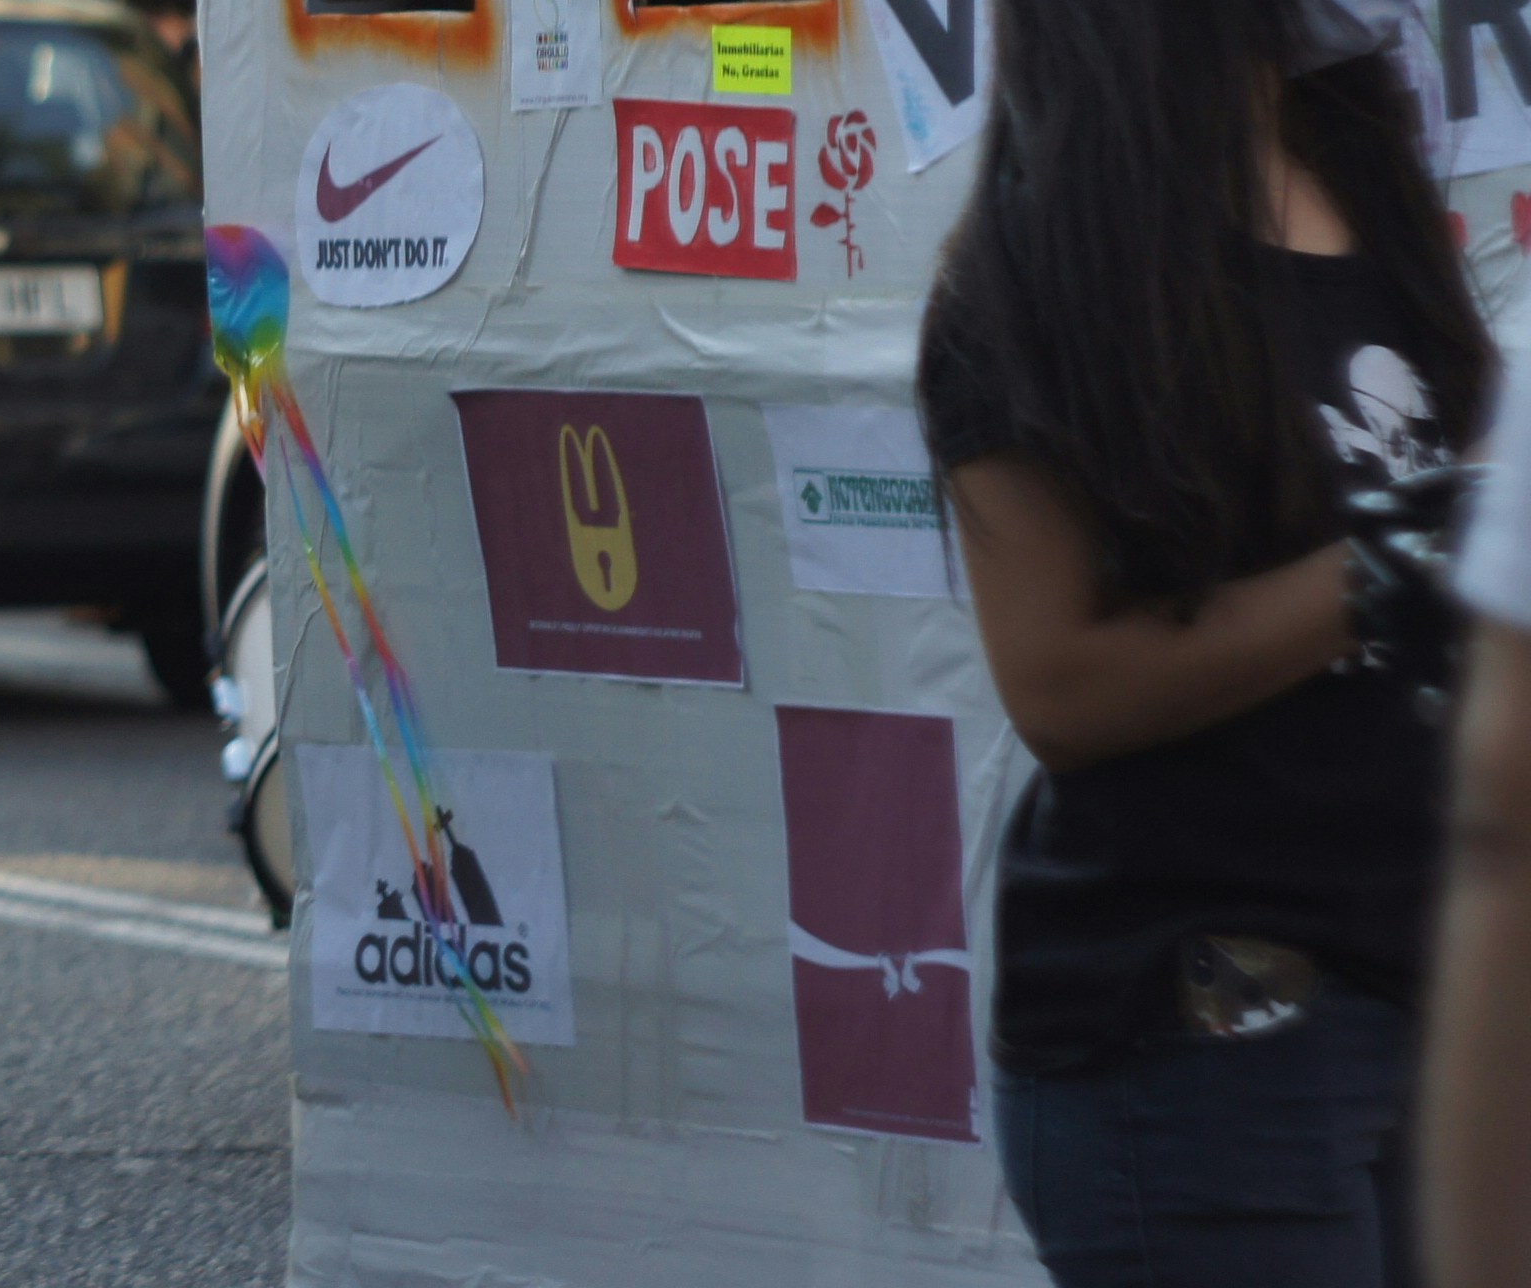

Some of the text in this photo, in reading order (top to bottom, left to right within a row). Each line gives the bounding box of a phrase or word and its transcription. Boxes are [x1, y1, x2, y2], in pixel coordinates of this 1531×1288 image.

[717, 41, 784, 58] Inmobiliarias
[741, 63, 781, 80] Gracias
[625, 124, 790, 249] POSE
[315, 237, 351, 270] JUST
[353, 237, 402, 269] DON'T
[404, 237, 429, 268] DO
[354, 920, 531, 994] adidas
